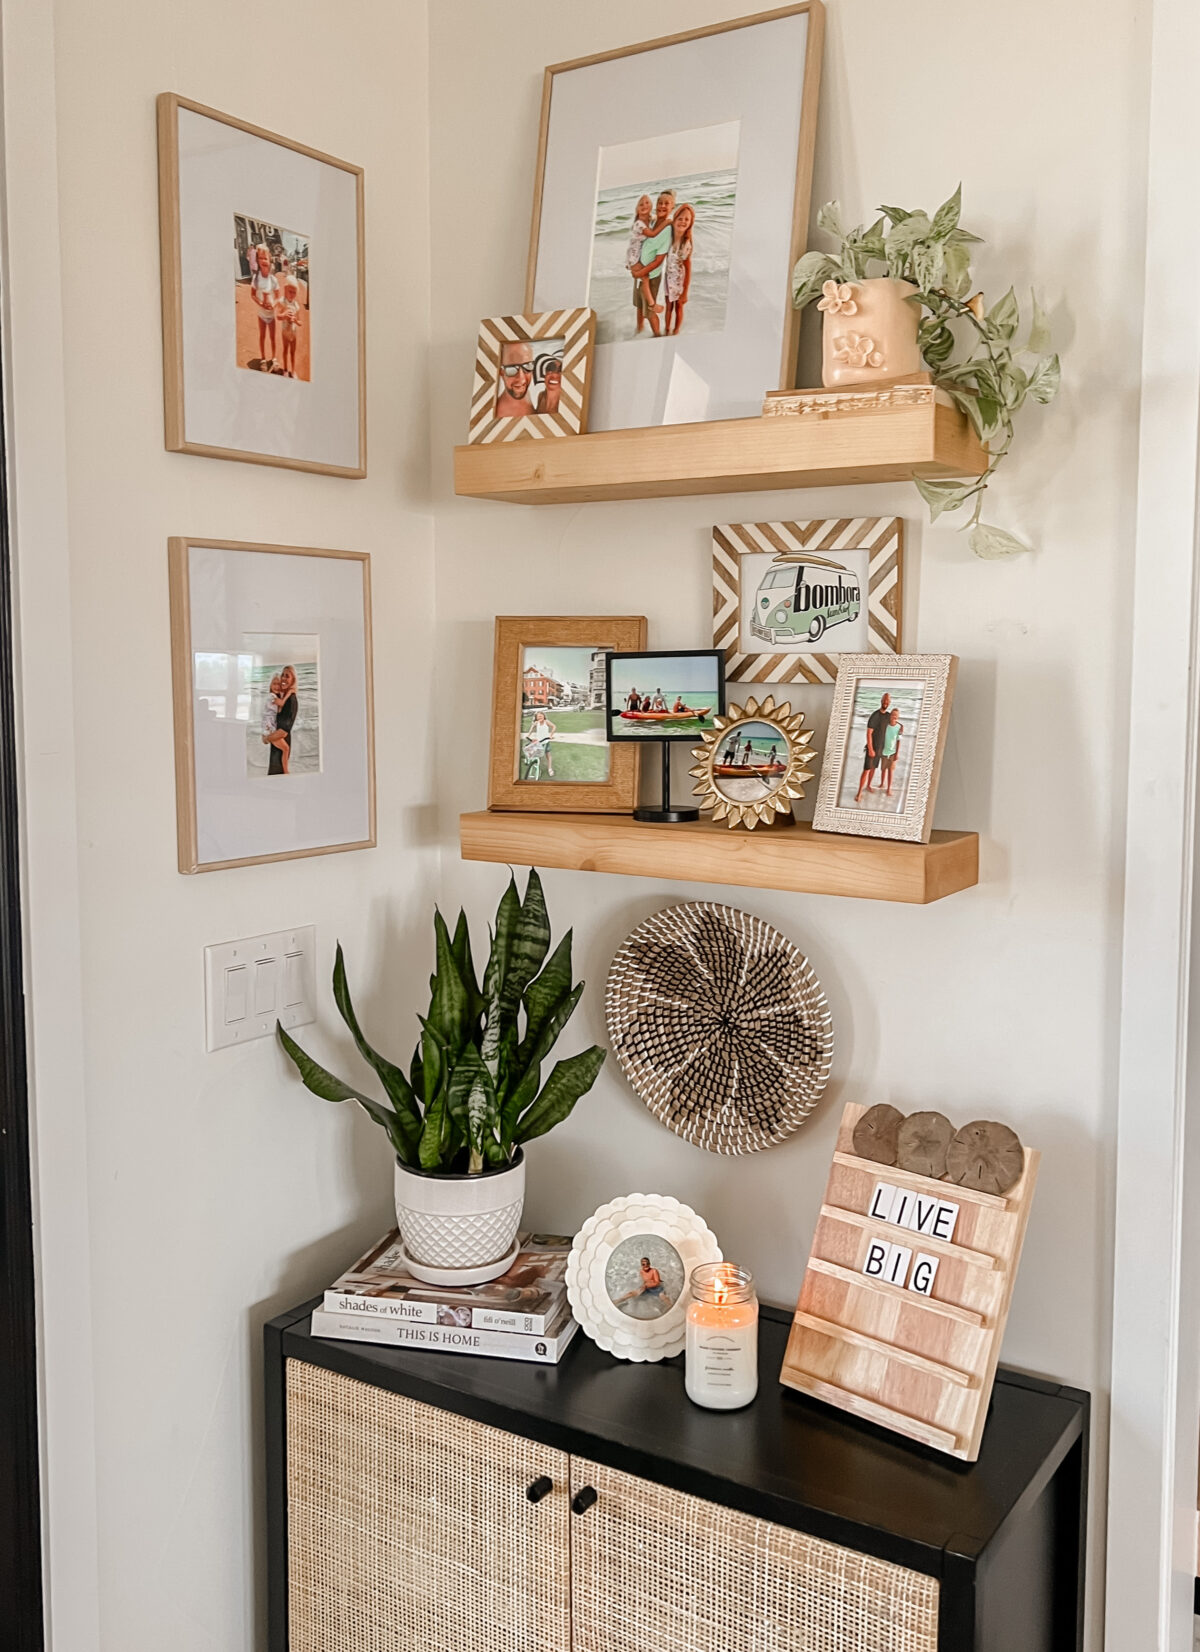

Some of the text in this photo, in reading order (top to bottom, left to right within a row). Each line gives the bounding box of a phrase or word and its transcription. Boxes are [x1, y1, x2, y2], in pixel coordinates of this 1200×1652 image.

[871, 1188, 954, 1239] LIVE
[865, 1244, 933, 1294] BIG
[339, 1298, 378, 1313] shades
[389, 1303, 422, 1318] white
[397, 1328, 480, 1347] THIS IS HOME
